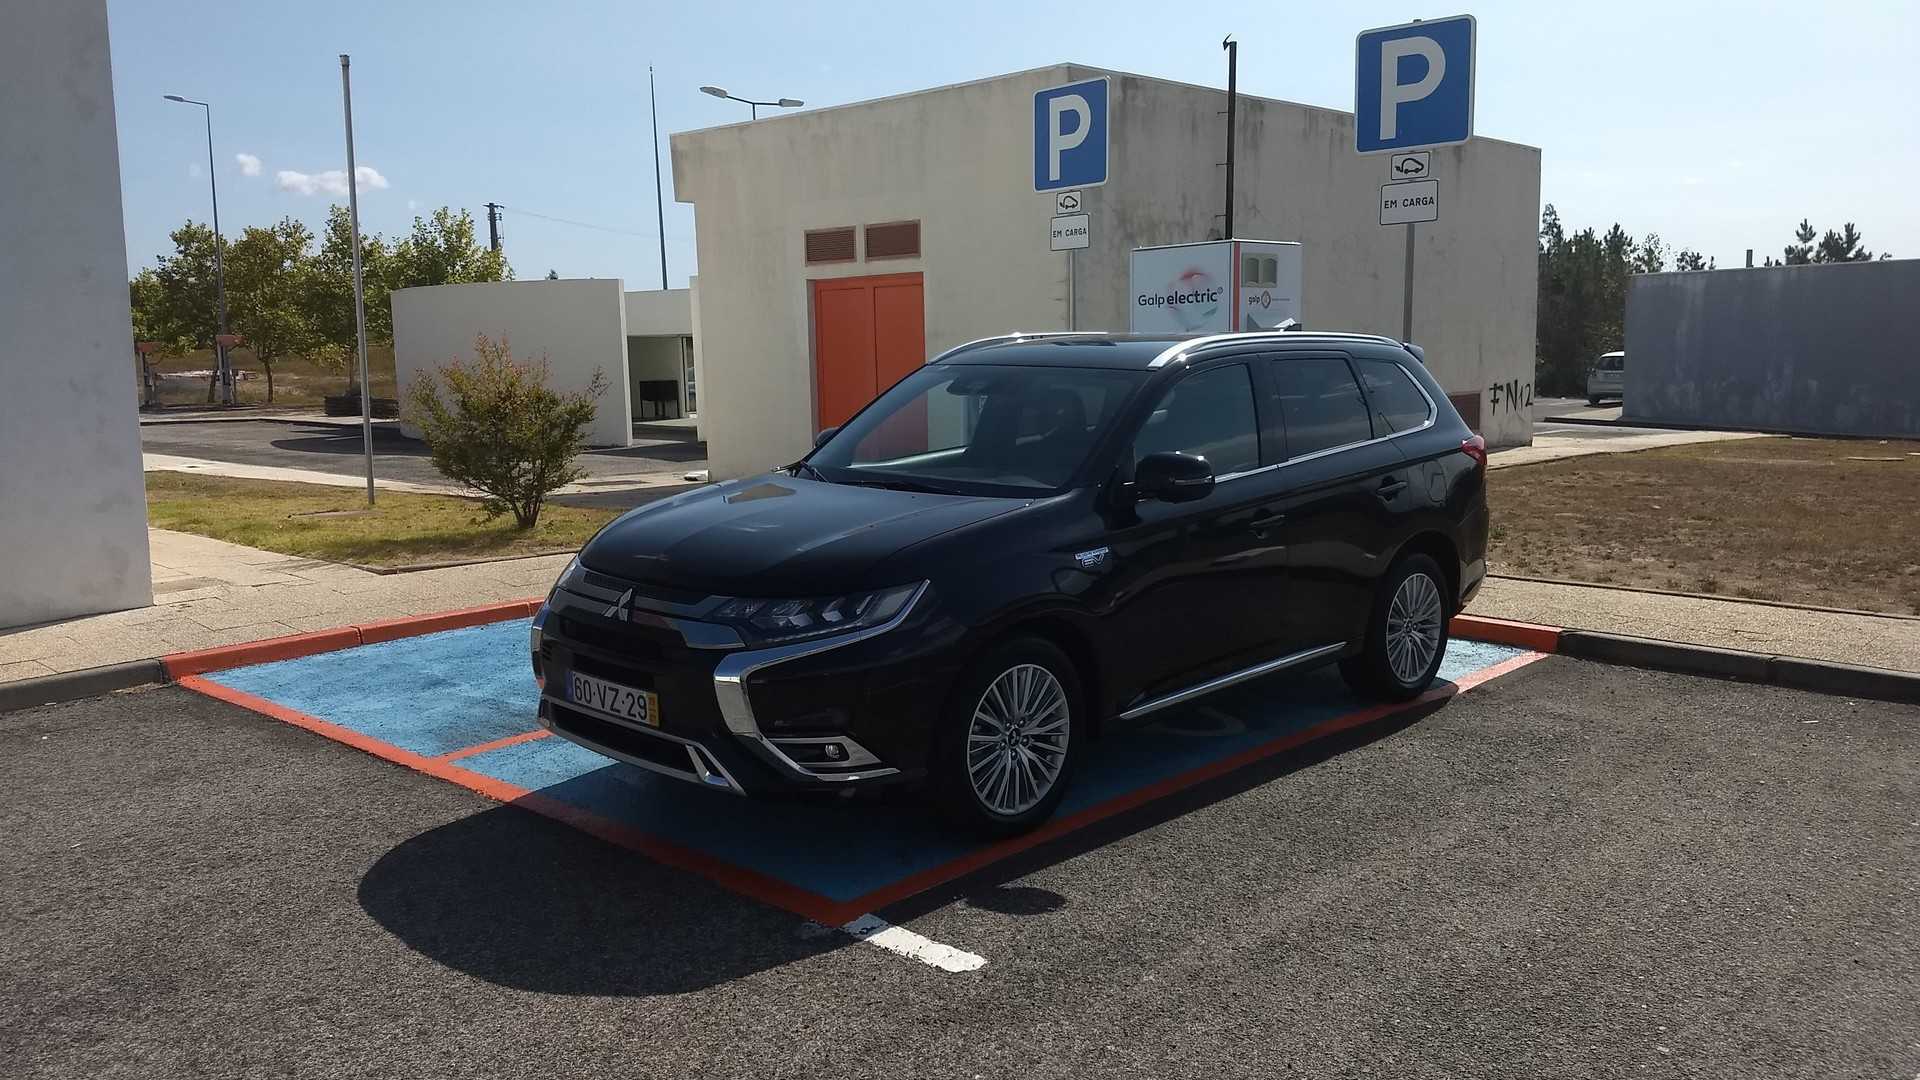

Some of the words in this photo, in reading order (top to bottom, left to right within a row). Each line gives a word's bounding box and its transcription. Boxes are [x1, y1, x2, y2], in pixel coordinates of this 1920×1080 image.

[1380, 36, 1447, 141] P
[1049, 93, 1092, 182] P
[1384, 199, 1398, 209] EM
[1402, 196, 1435, 208] CARGA
[1052, 230, 1063, 238] EM
[1065, 227, 1087, 237] CARGA
[1137, 293, 1166, 309] Galp
[1166, 287, 1218, 305] electric
